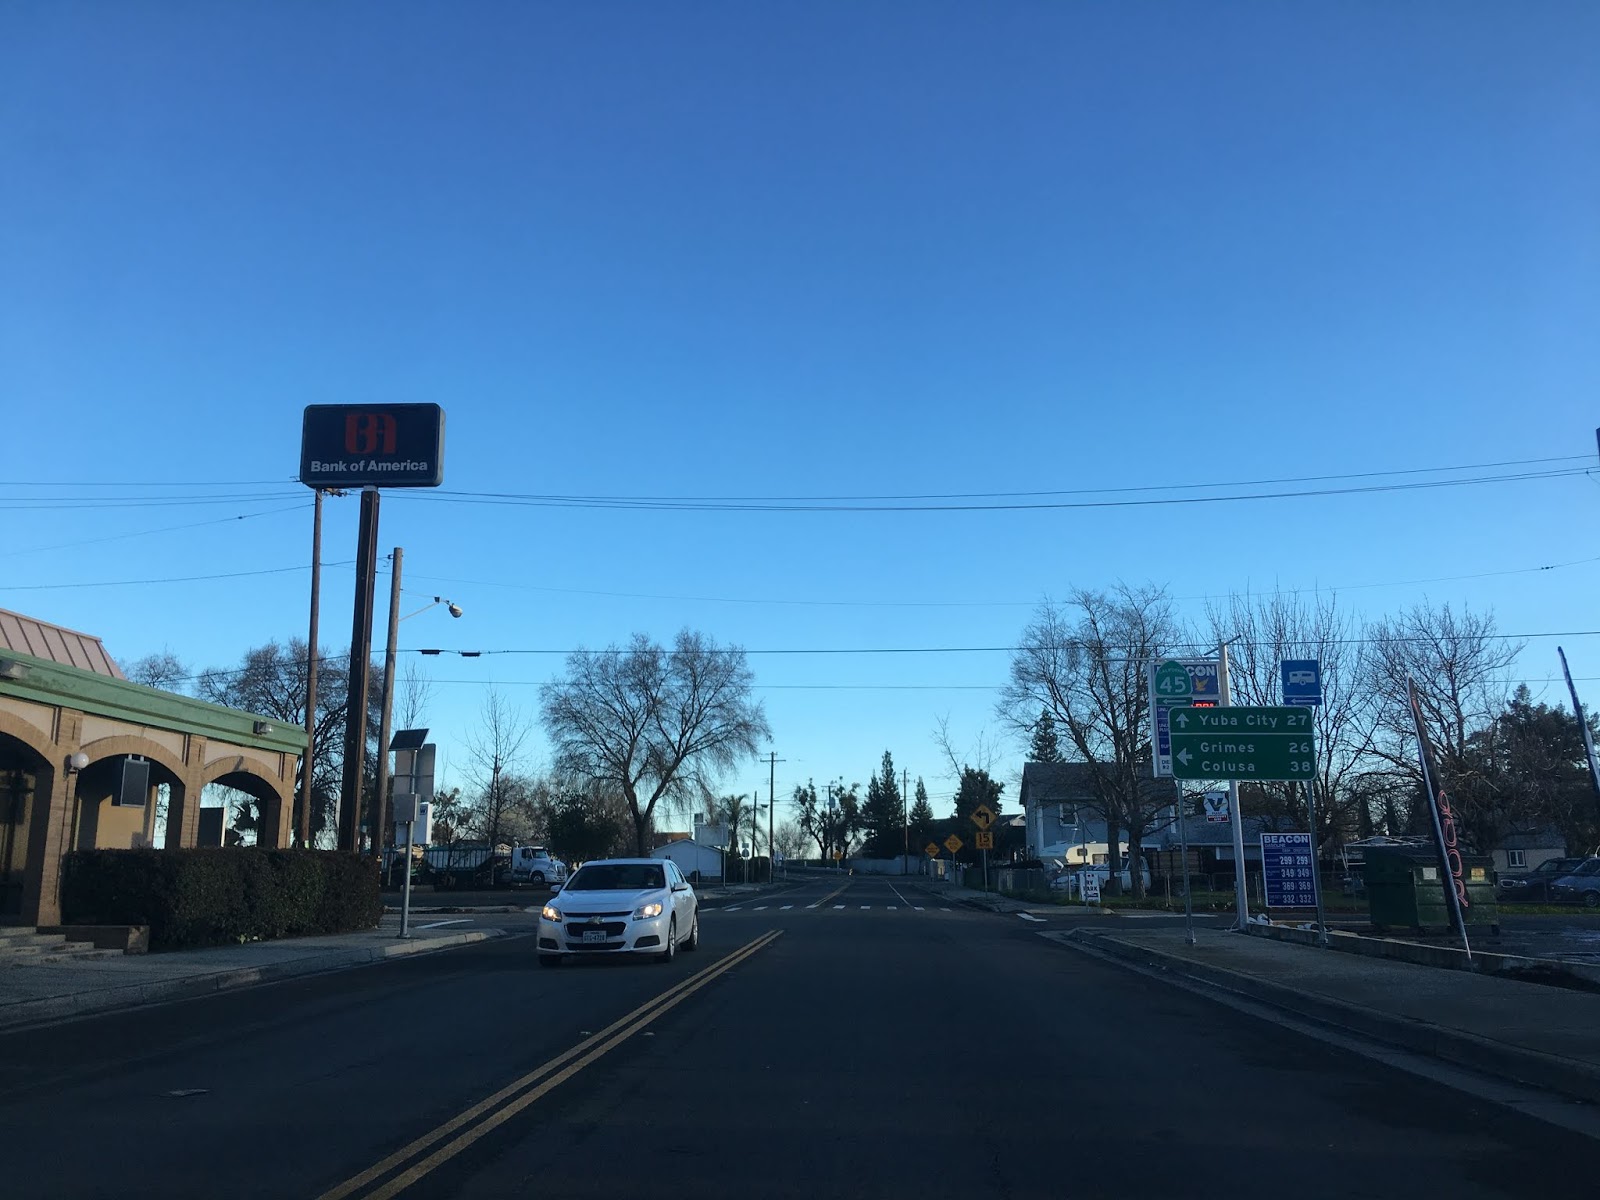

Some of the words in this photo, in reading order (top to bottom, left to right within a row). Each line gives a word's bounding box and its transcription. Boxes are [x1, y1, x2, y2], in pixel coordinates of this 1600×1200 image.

[310, 460, 347, 472] Bank
[350, 460, 366, 471] of
[367, 460, 428, 471] America
[1159, 676, 1186, 693] 45
[1199, 715, 1238, 727] Yuba
[1246, 715, 1278, 728] City
[1287, 715, 1308, 726] 27
[1200, 742, 1255, 753] Grimes
[1288, 742, 1310, 753] 26
[1201, 760, 1255, 772] Colusa
[1290, 760, 1311, 772] 38
[979, 833, 989, 843] 15
[1263, 835, 1309, 844] BEACON
